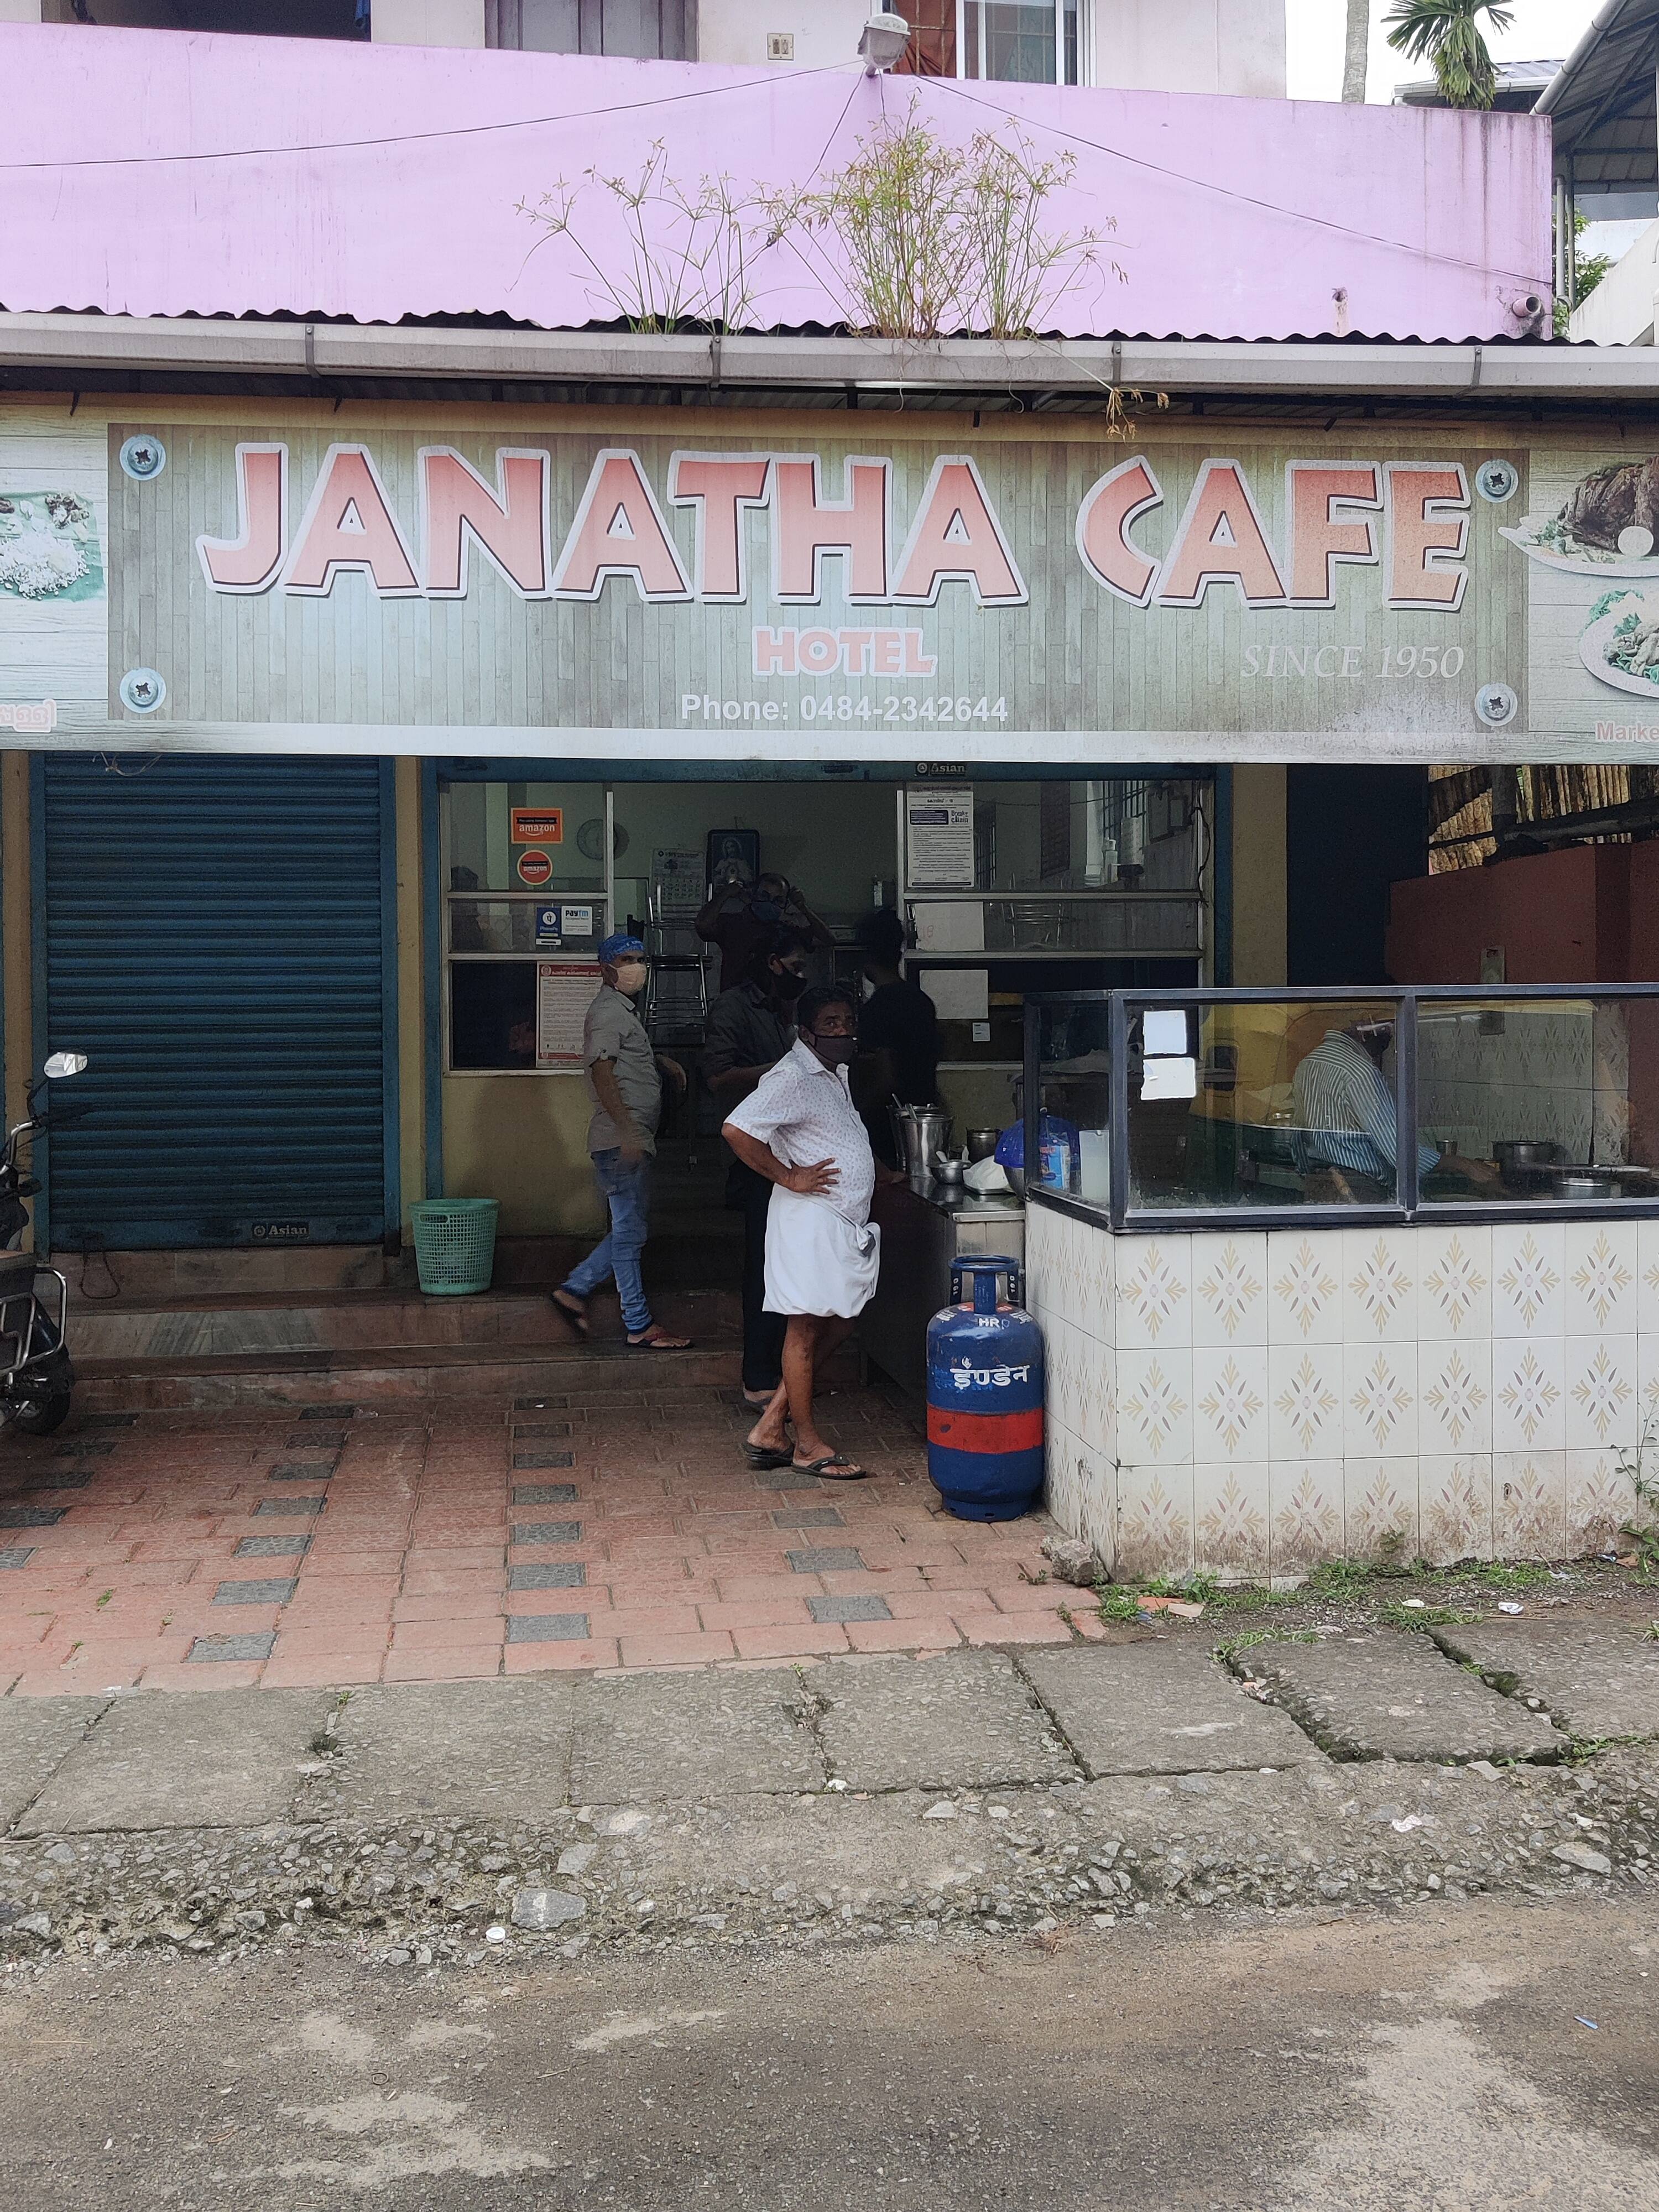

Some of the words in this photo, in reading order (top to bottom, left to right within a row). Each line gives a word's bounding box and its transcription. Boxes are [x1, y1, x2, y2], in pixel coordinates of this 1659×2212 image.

[195, 442, 1029, 607] JANATHA
[1075, 455, 1472, 611] CAFE
[753, 625, 938, 677] HOTEL
[1240, 644, 1363, 678] SINCE
[1375, 645, 1465, 679] 1950
[681, 694, 789, 721] Phone:
[800, 695, 1008, 722] 0484-2342644
[931, 763, 966, 773] Asian
[268, 1224, 307, 1235] Asian
